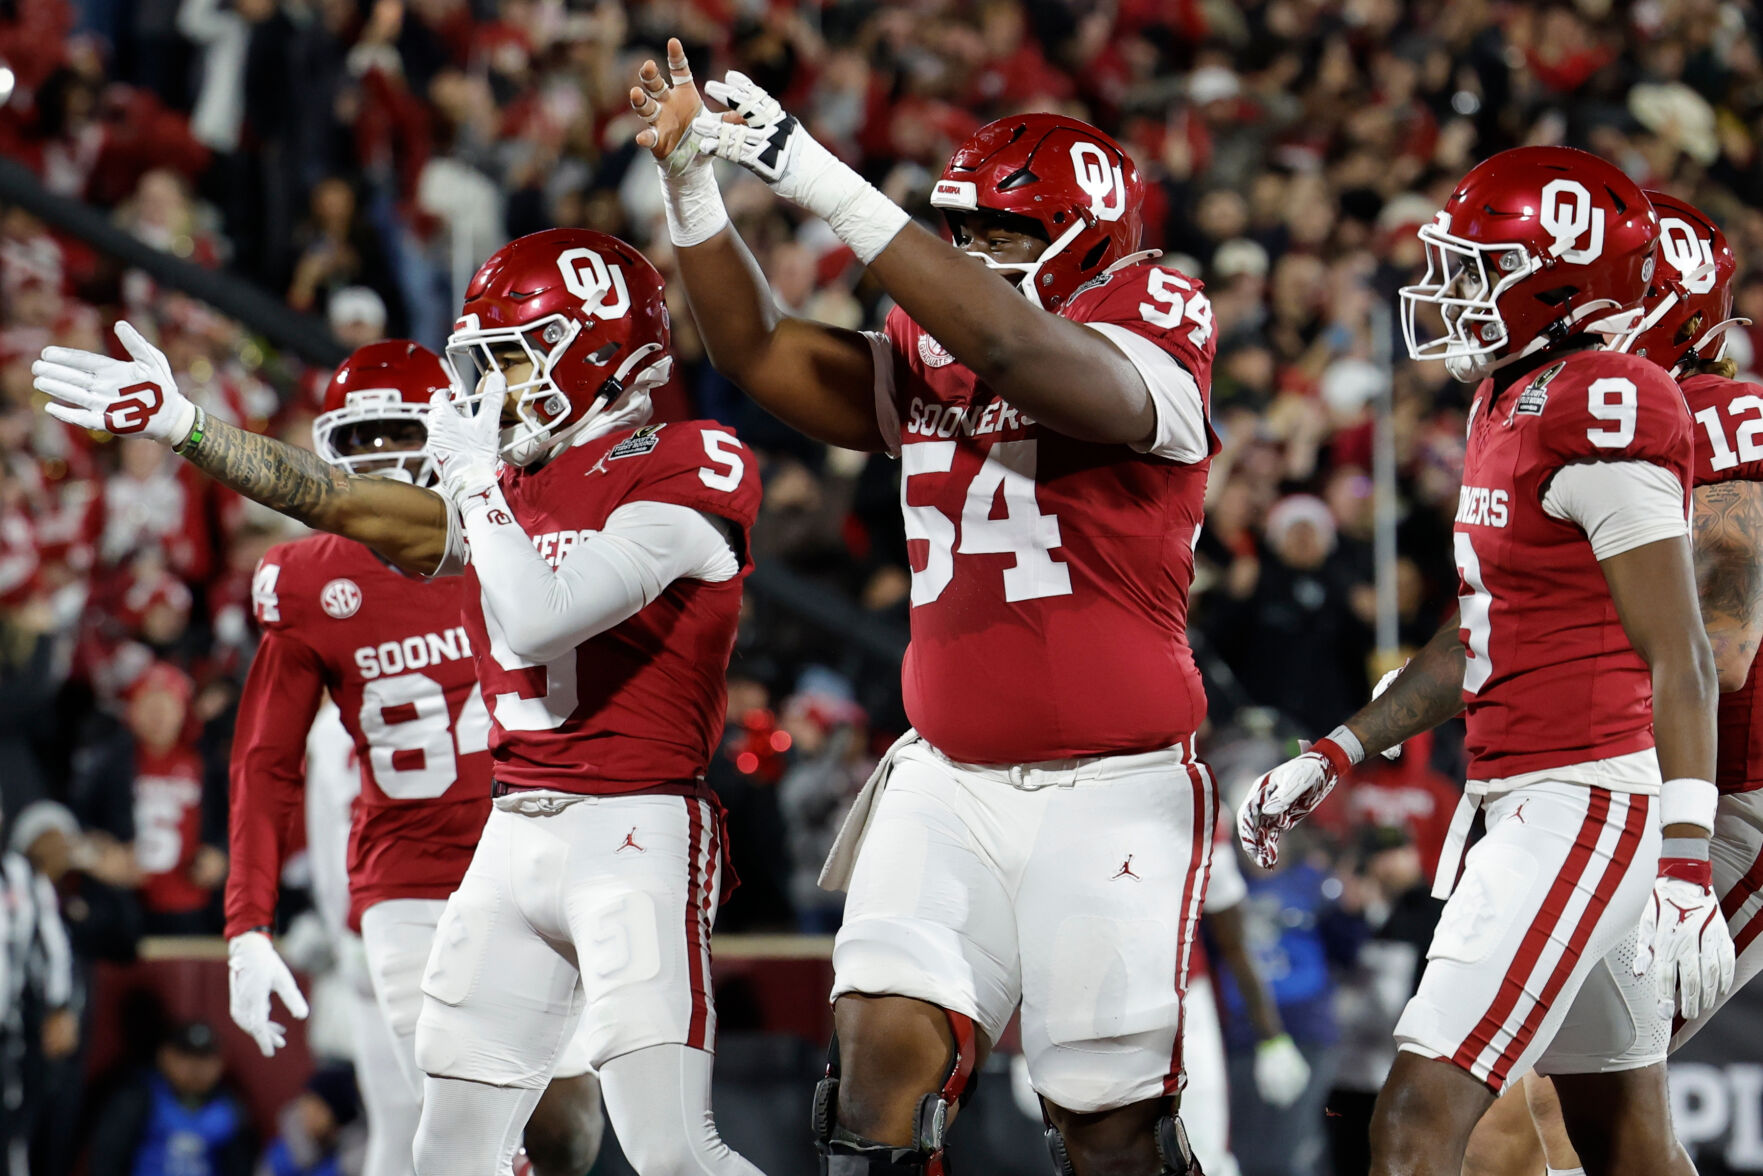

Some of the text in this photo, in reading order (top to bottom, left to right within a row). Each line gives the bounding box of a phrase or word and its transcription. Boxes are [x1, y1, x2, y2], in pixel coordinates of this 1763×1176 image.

[1069, 141, 1126, 221] OU
[1540, 178, 1605, 265] OU
[1659, 217, 1716, 294] OU
[556, 247, 631, 320] OU
[1139, 267, 1212, 350] 54
[103, 380, 164, 435] OU
[907, 396, 1036, 438] SOONER
[1587, 377, 1638, 448] 9
[1694, 394, 1763, 472] 12
[699, 429, 745, 493] 5
[900, 438, 1073, 608] 54
[252, 557, 281, 622] 4
[324, 580, 360, 616] SEC
